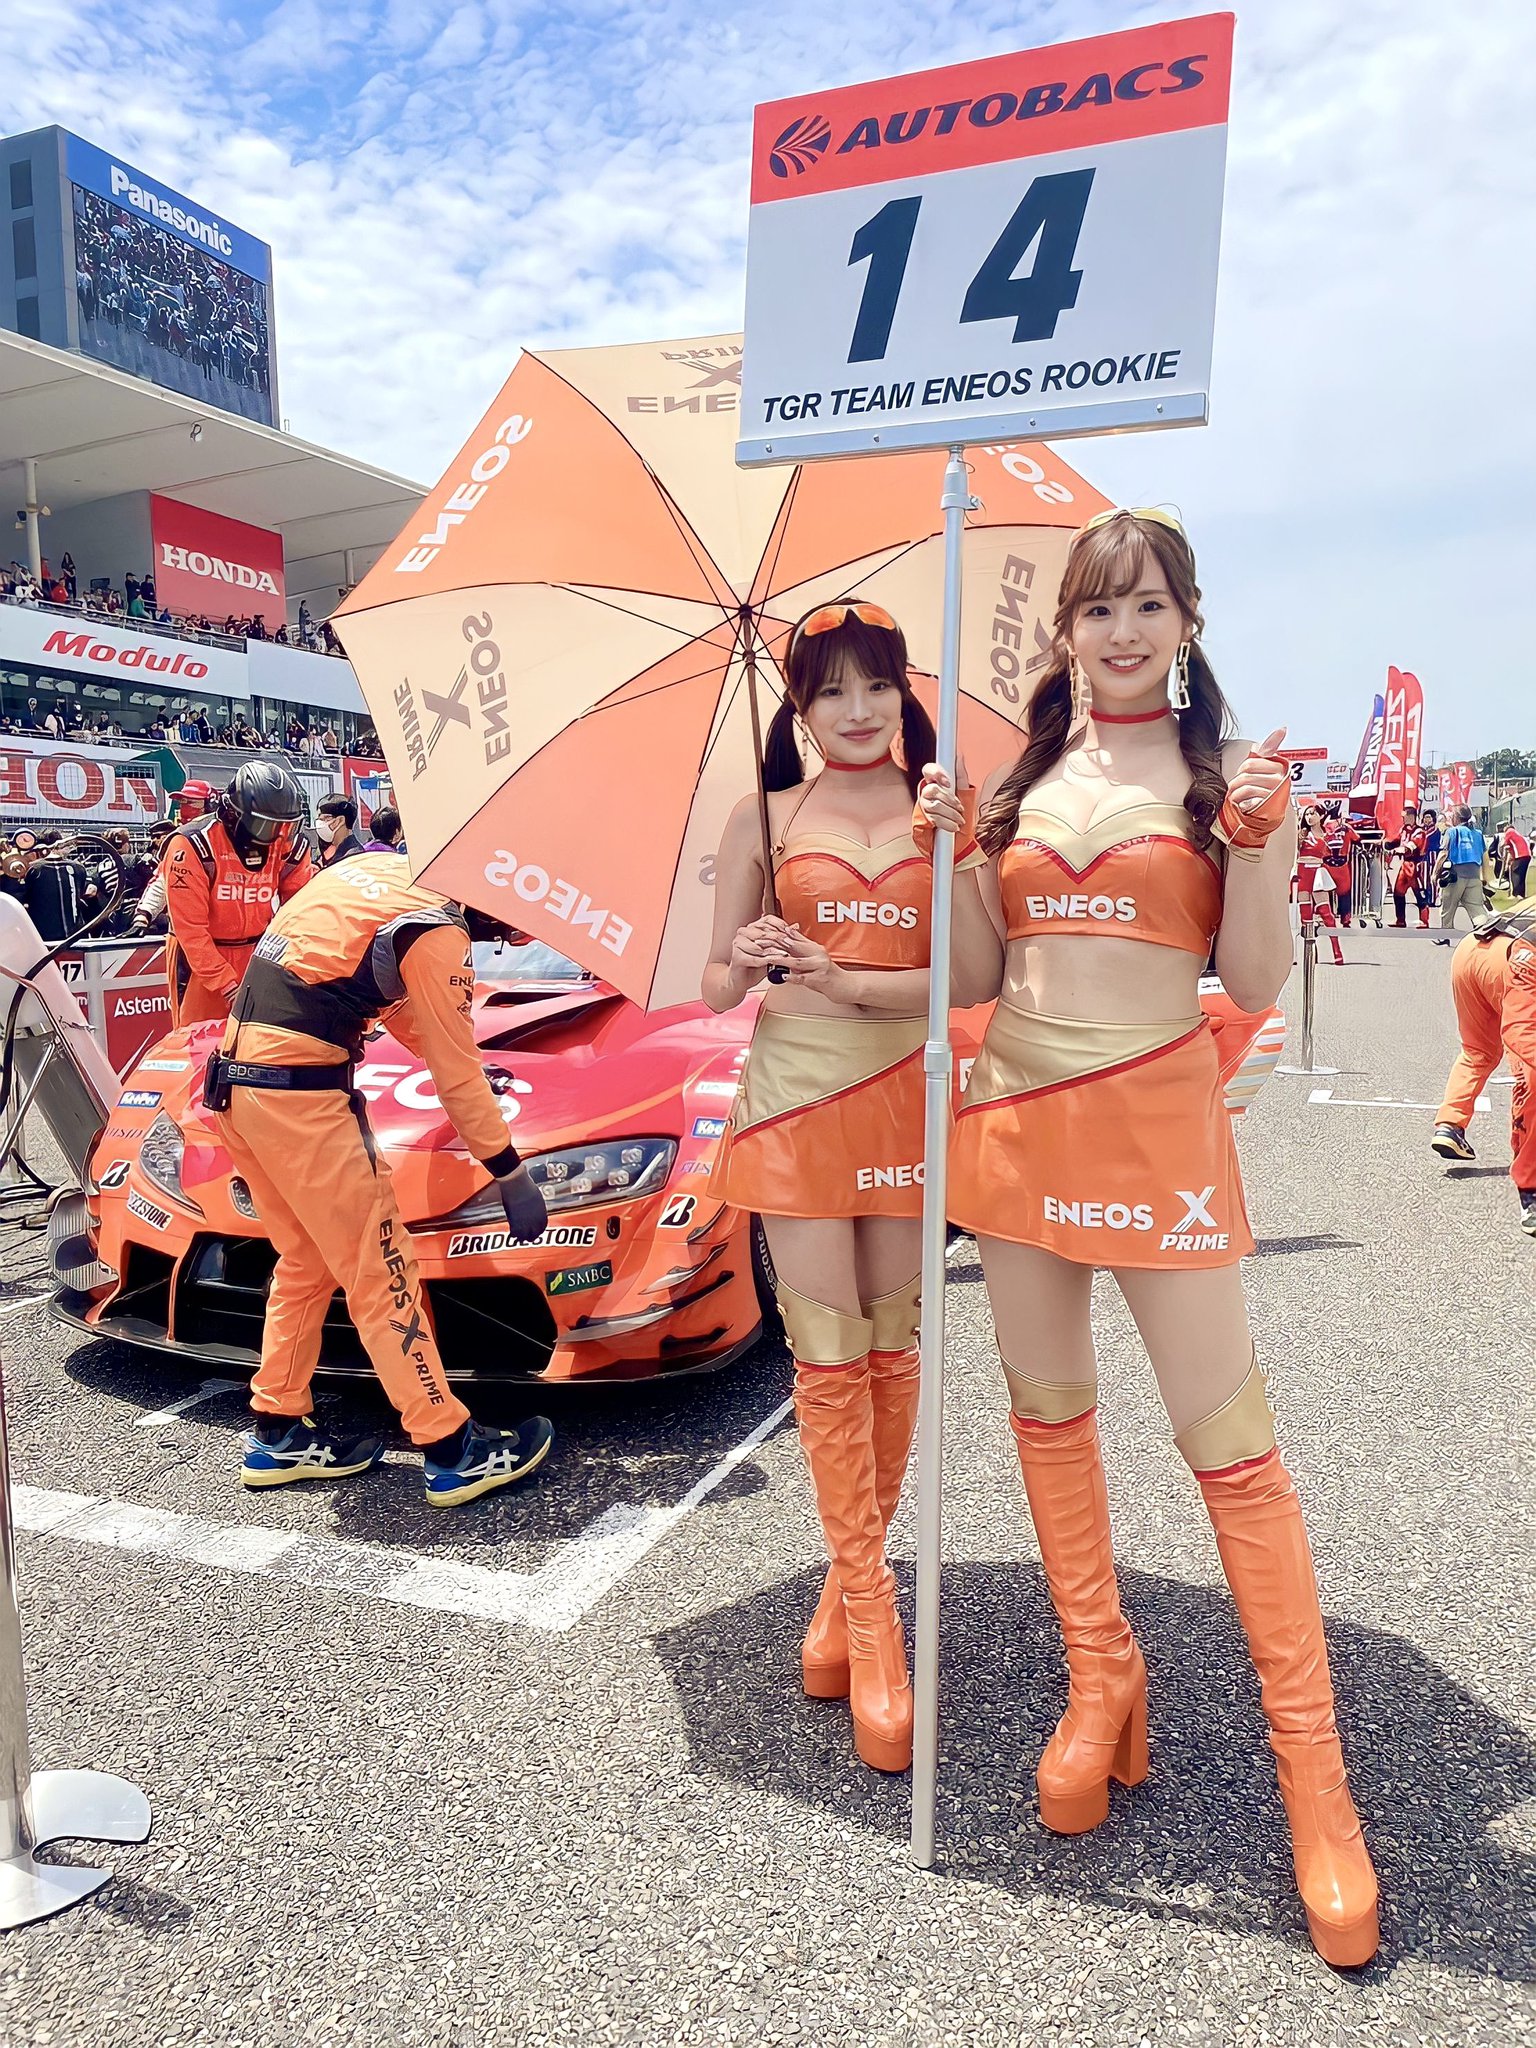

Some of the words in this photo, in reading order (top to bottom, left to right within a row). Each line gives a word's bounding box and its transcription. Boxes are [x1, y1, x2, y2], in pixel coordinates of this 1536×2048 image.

[836, 54, 1209, 154] AUTOBACS
[111, 164, 233, 256] Panasonic
[763, 392, 821, 423] TGR
[832, 381, 915, 415] TEAM
[922, 367, 1033, 406] ENEOS
[1041, 350, 1181, 393] ROOKIE
[160, 543, 281, 597] HONDA
[42, 630, 209, 679] Modulo
[217, 884, 278, 904] ENEO
[1026, 894, 1138, 923] ENEOS
[817, 900, 919, 929] ENEOS
[62, 963, 82, 983] 17
[857, 1161, 927, 1192] ENEO
[1044, 1196, 1154, 1231] ENEOS
[1174, 1186, 1219, 1234] X
[1159, 1232, 1229, 1251] PRIME
[568, 1265, 611, 1288] SMBC
[380, 1218, 412, 1310] ENEOS
[411, 1351, 445, 1406] PRIME
